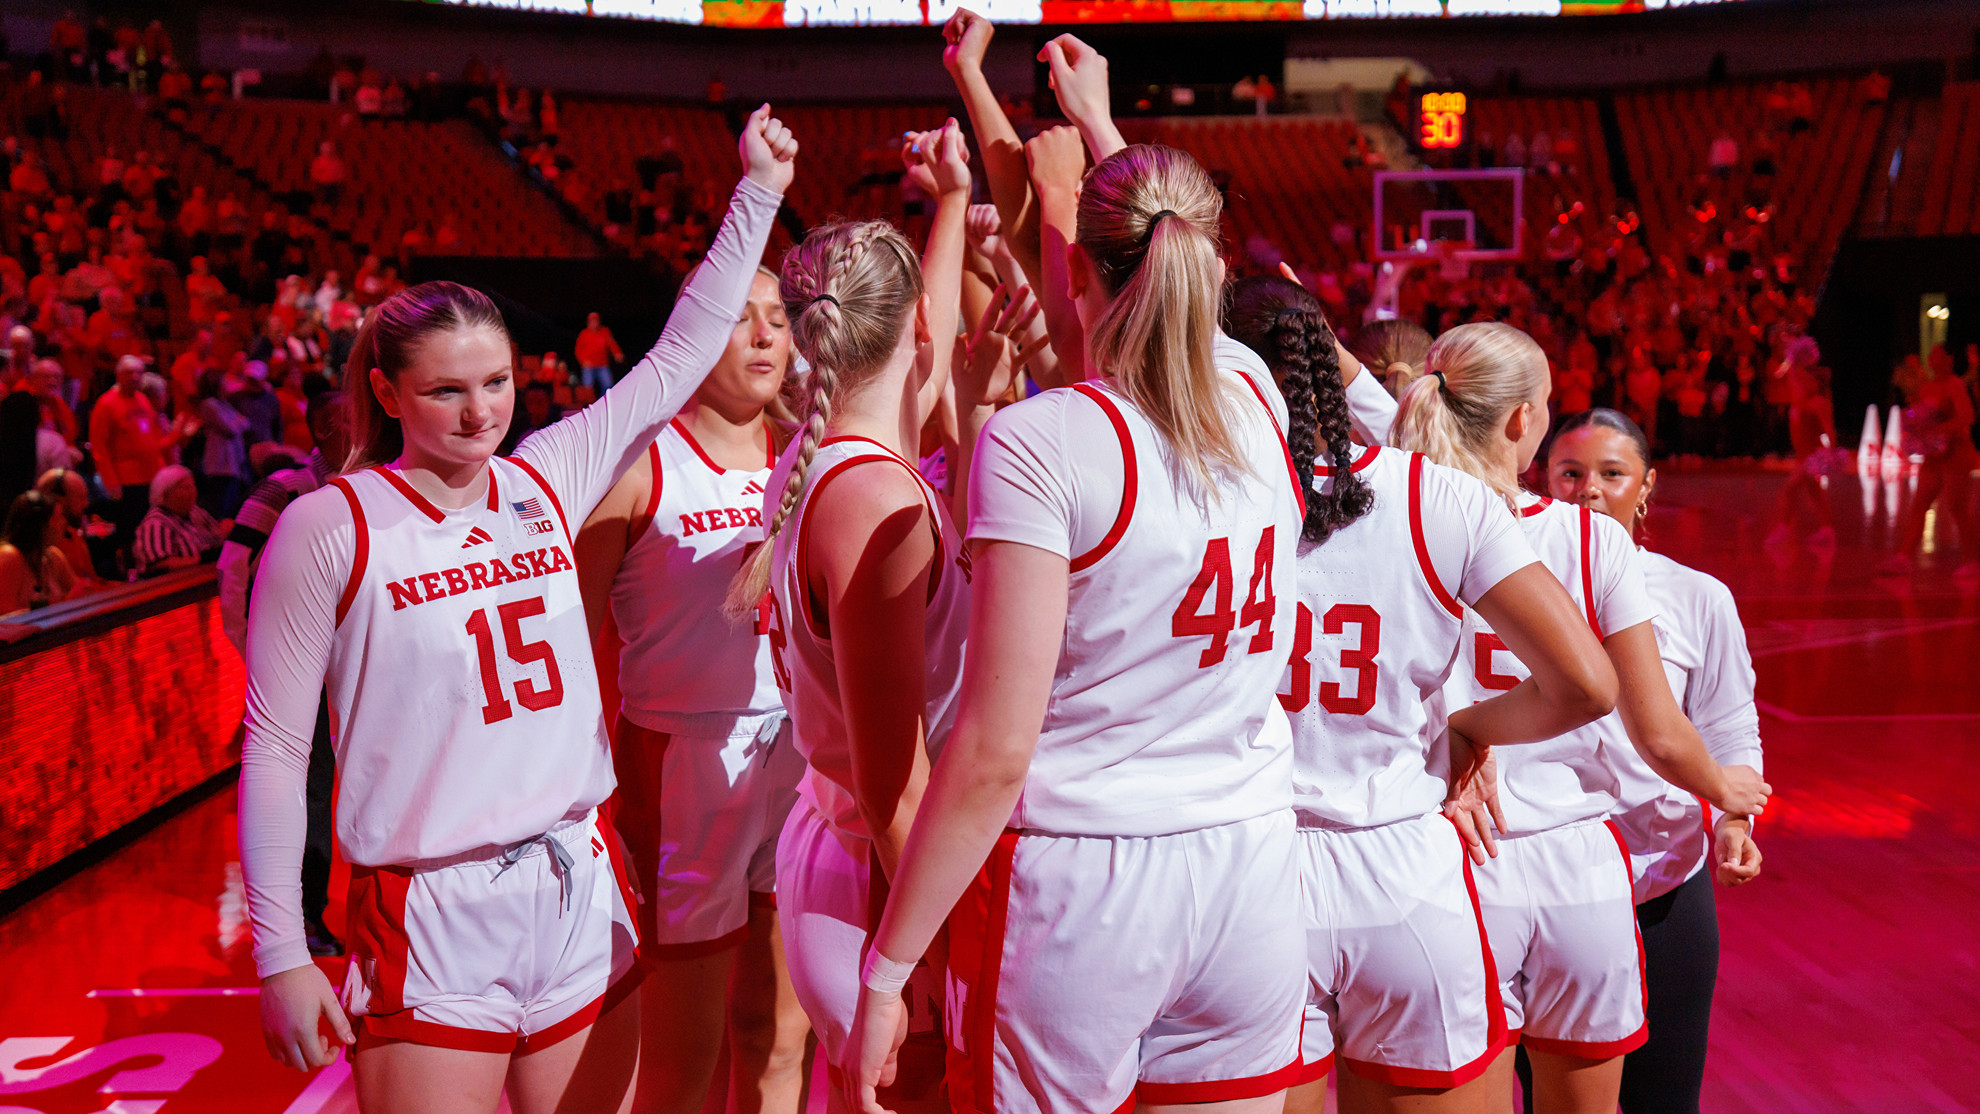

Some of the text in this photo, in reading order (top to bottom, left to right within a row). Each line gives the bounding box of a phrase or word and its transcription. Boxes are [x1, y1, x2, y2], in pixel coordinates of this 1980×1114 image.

[1421, 112, 1462, 149] 30
[385, 545, 573, 611] NEBRASKA
[1171, 524, 1276, 669] 44
[465, 595, 564, 725] 15
